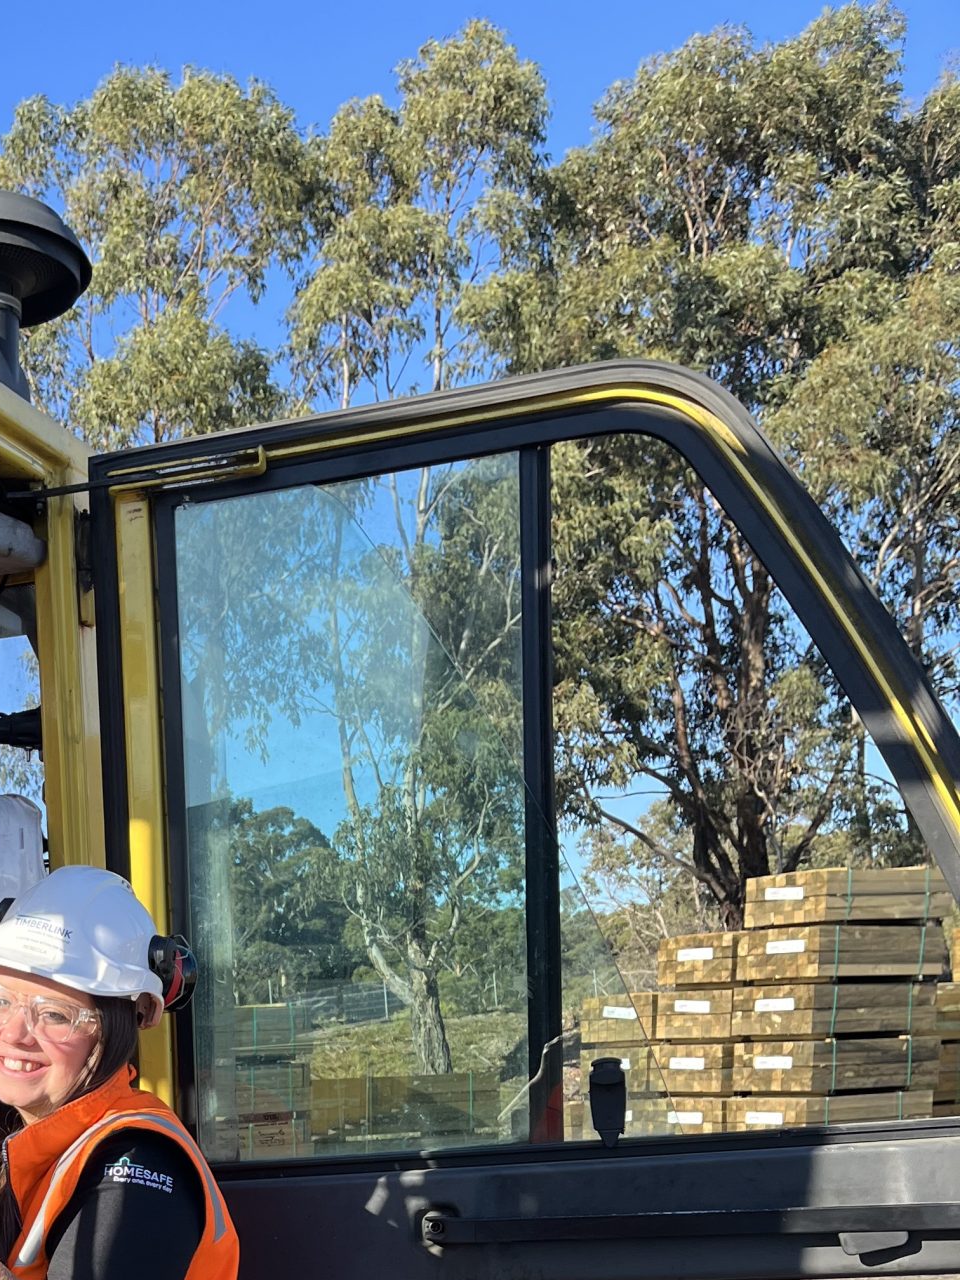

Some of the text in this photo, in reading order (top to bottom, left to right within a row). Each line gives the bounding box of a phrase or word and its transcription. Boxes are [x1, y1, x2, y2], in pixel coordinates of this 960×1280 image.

[15, 917, 72, 939] TIMBERLINK
[104, 1166, 173, 1187] HOMESAFE
[113, 1176, 132, 1184] Every
[145, 1180, 161, 1190] every
[162, 1184, 173, 1194] day
